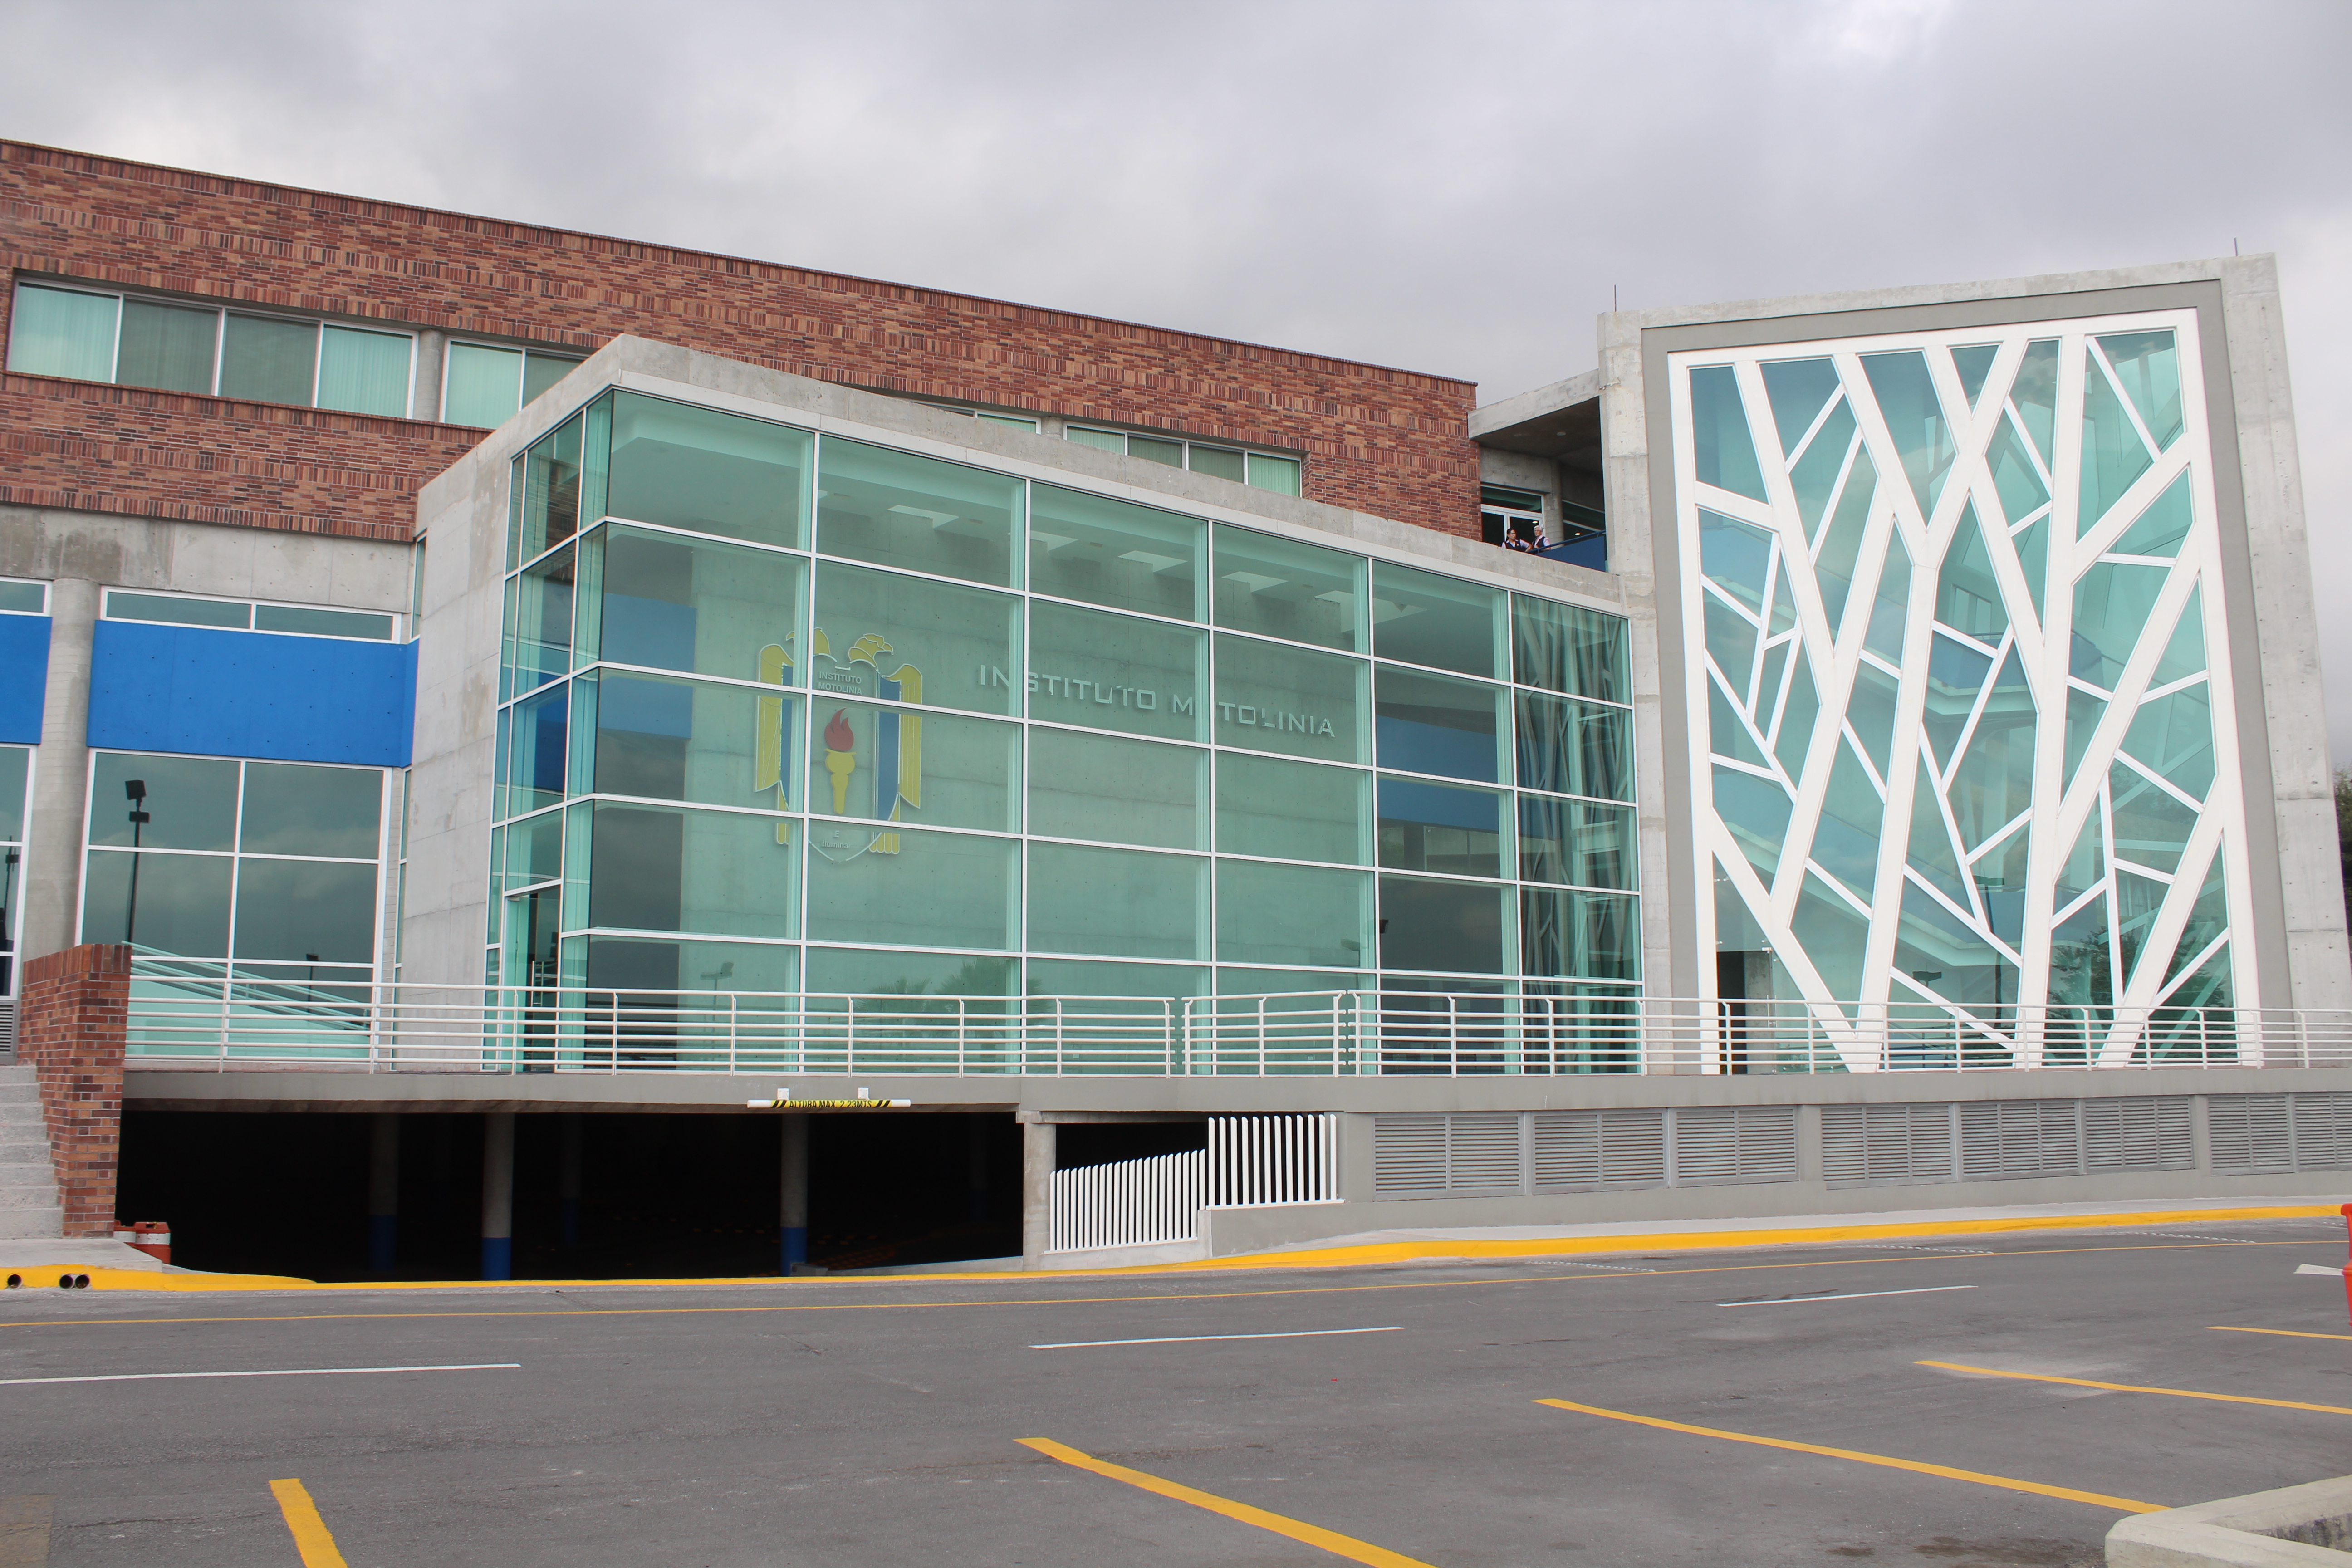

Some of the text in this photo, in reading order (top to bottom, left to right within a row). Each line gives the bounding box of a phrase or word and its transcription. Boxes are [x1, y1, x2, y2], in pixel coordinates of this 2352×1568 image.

[819, 671, 862, 684] INSTITUTO
[818, 682, 862, 695] MOTOLINIA
[1172, 694, 1335, 738] MTOLINIA
